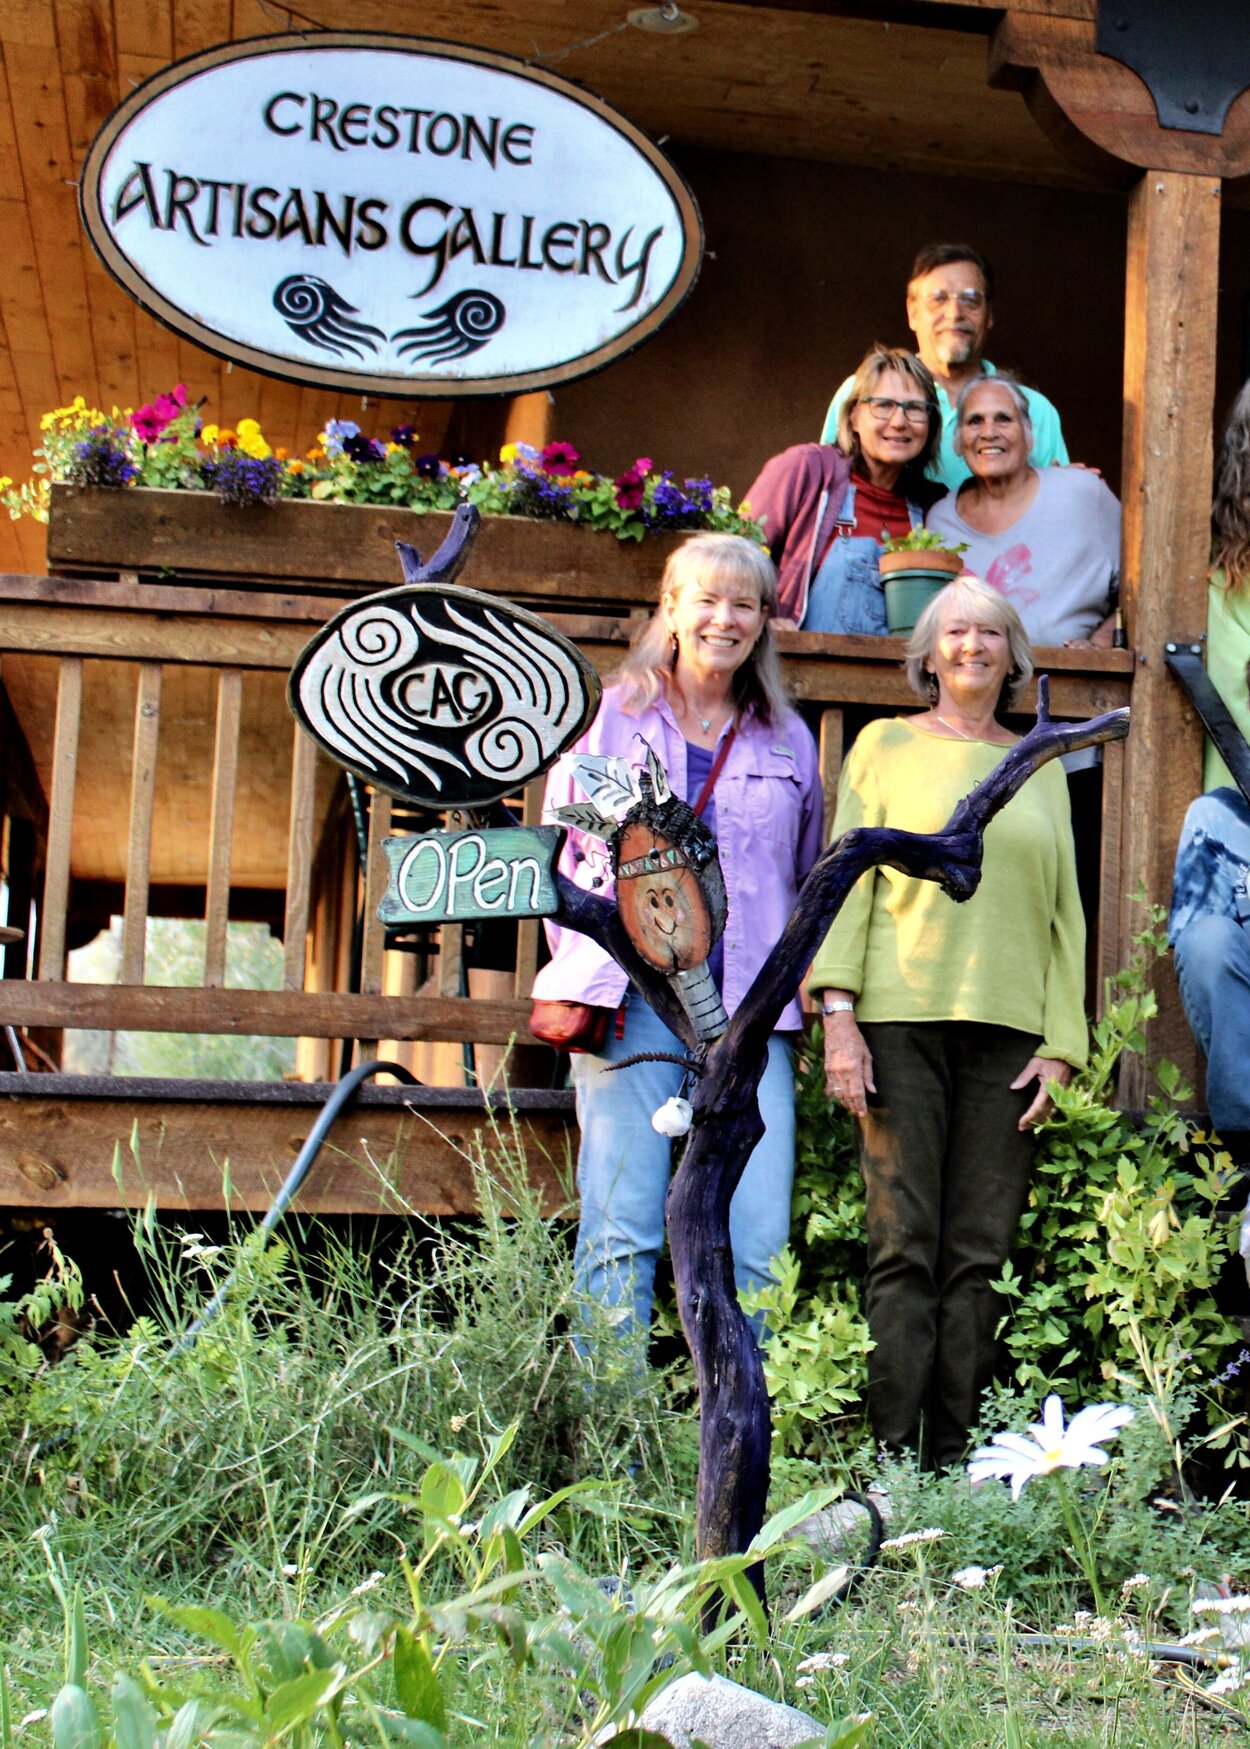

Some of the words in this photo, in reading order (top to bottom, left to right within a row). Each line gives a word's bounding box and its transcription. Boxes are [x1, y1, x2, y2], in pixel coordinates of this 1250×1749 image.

[264, 91, 537, 169] CRESTONE
[112, 160, 389, 258] ARTISANS
[400, 197, 664, 313] GALLERY
[399, 666, 489, 721] CAG
